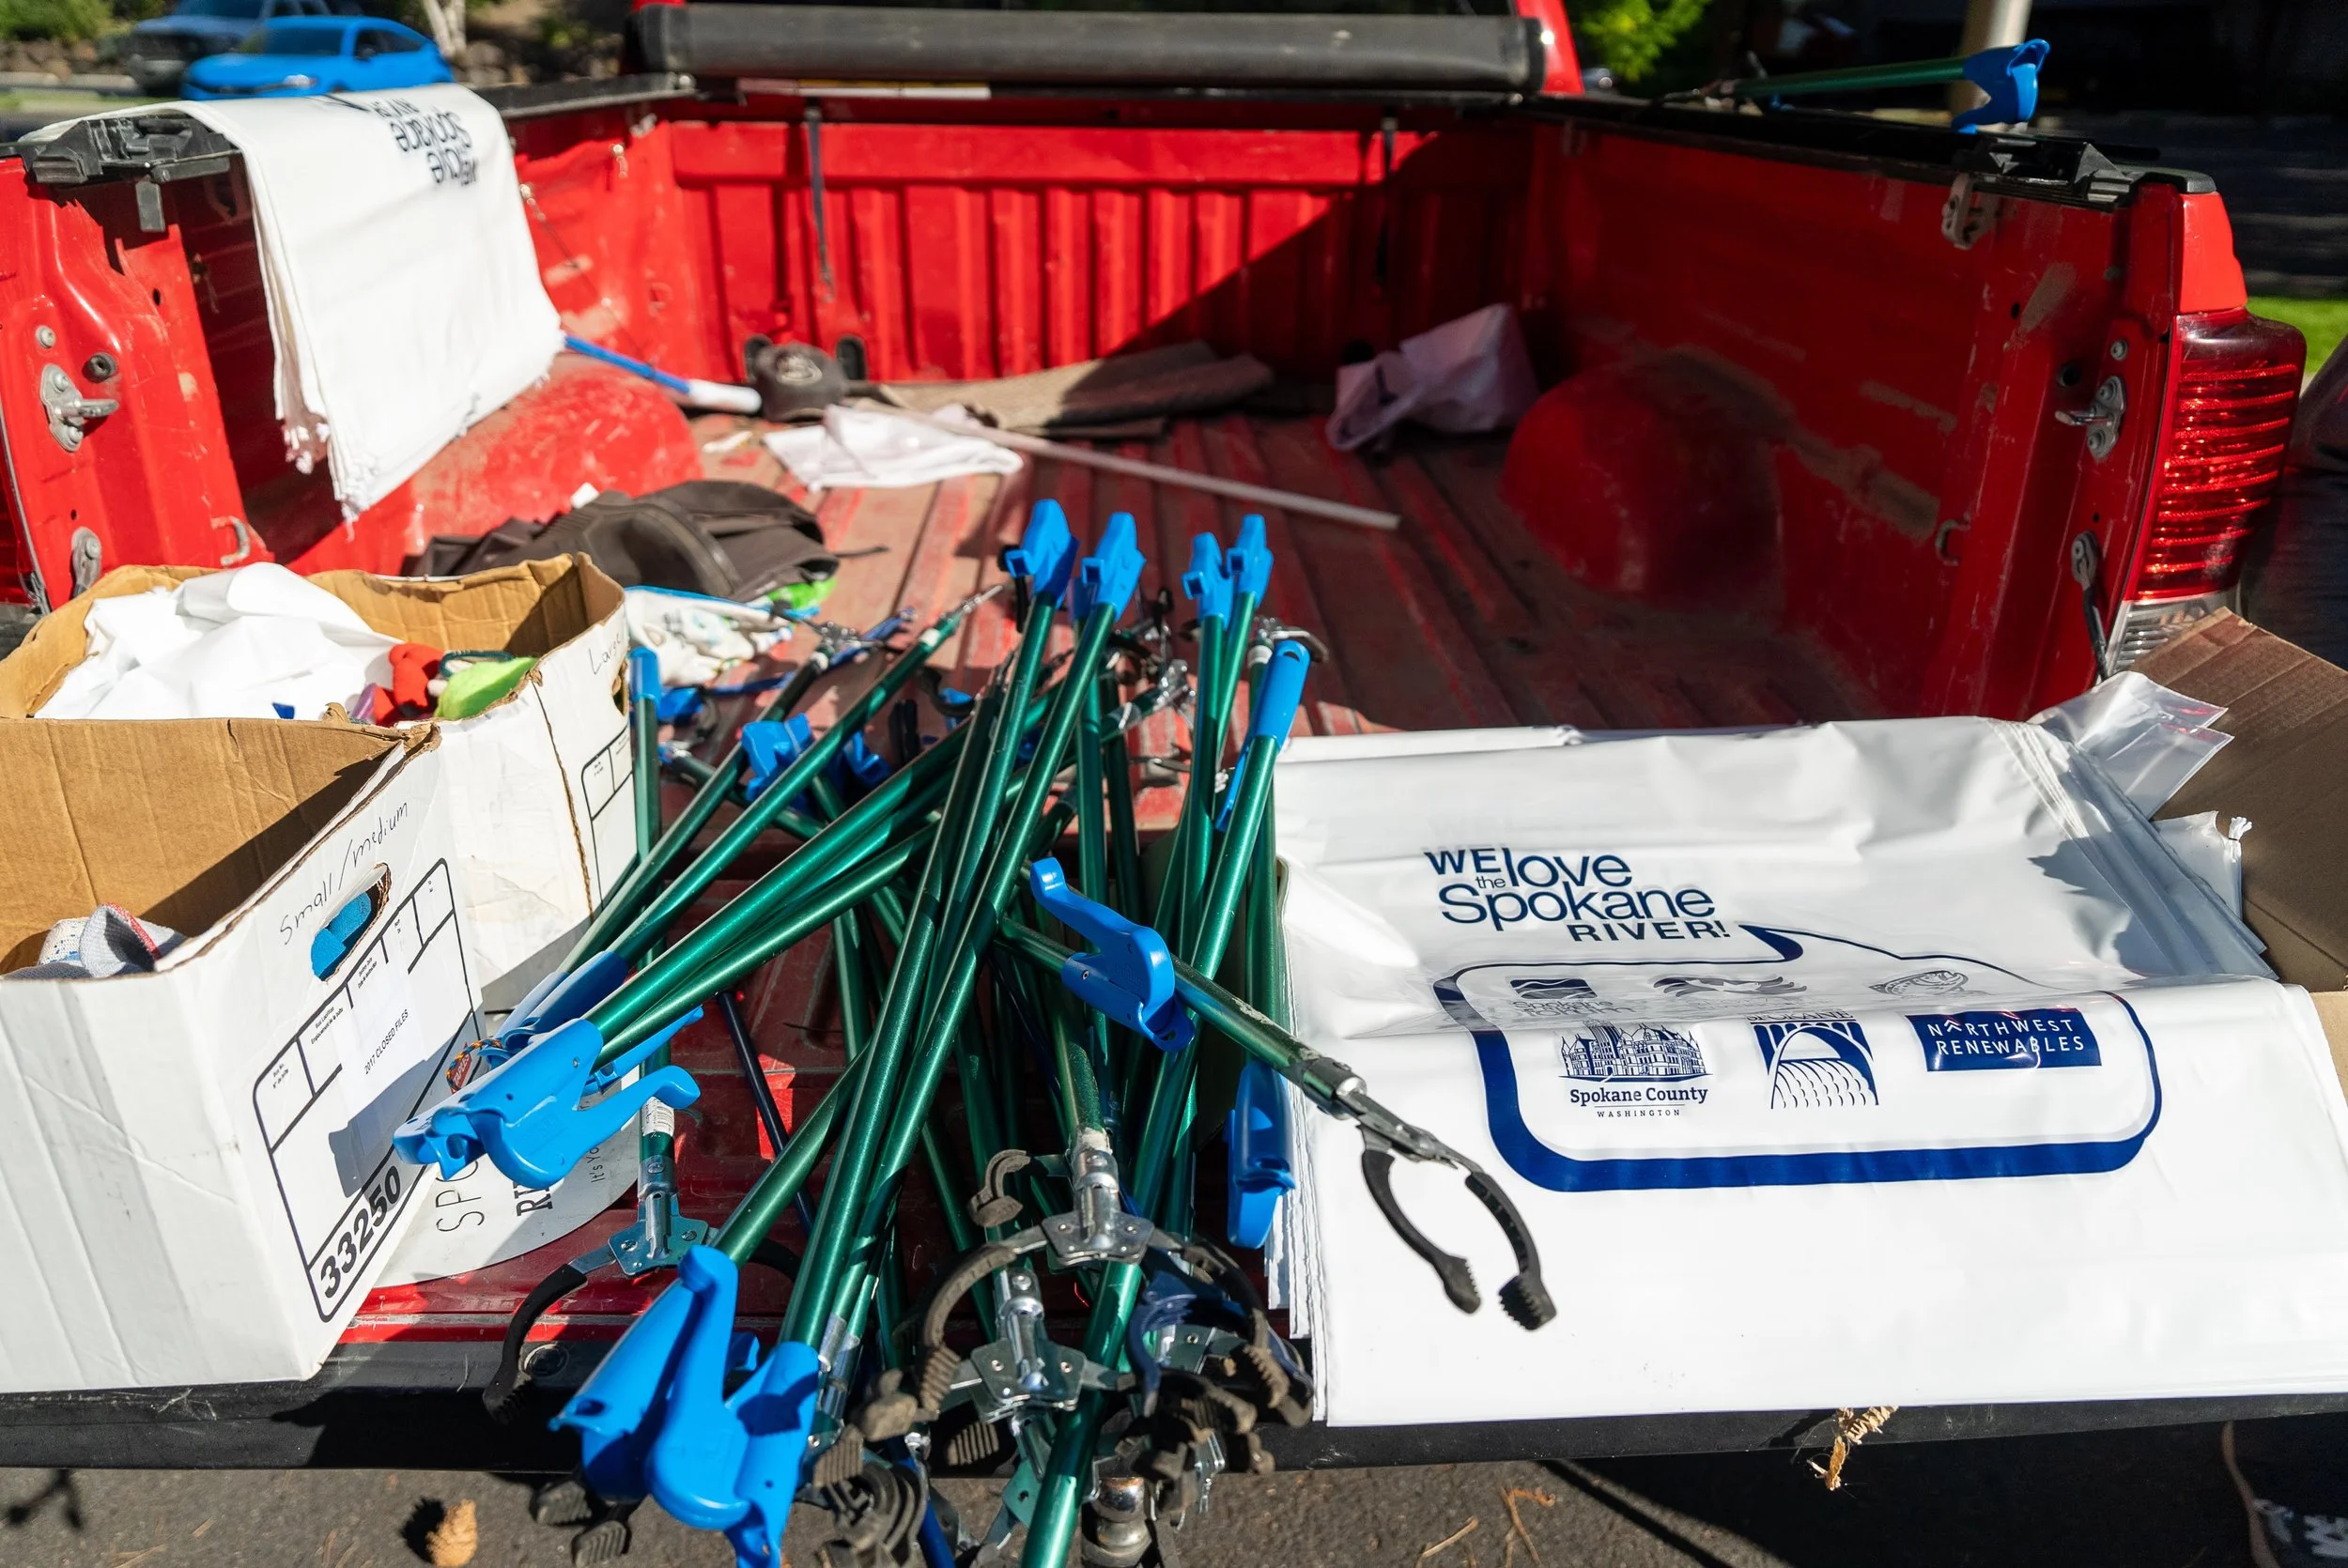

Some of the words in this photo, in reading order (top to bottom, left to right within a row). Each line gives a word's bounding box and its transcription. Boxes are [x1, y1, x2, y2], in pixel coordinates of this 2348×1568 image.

[1424, 847, 1501, 875] WE
[1502, 847, 1632, 887] love
[1475, 876, 1506, 889] the
[1438, 881, 1715, 931] Spokane
[1567, 920, 1731, 943] RIVER!
[364, 1054, 376, 1075] 2017
[376, 1027, 395, 1058] CLOSED
[394, 1008, 409, 1032] FILES
[1935, 1036, 2084, 1055] RENEWABLES
[1569, 1087, 1642, 1107] Spokane
[1645, 1086, 1708, 1104] County
[1597, 1109, 1680, 1118] WASHINGTON
[591, 1164, 605, 1183] It's
[320, 1165, 401, 1299] 33250
